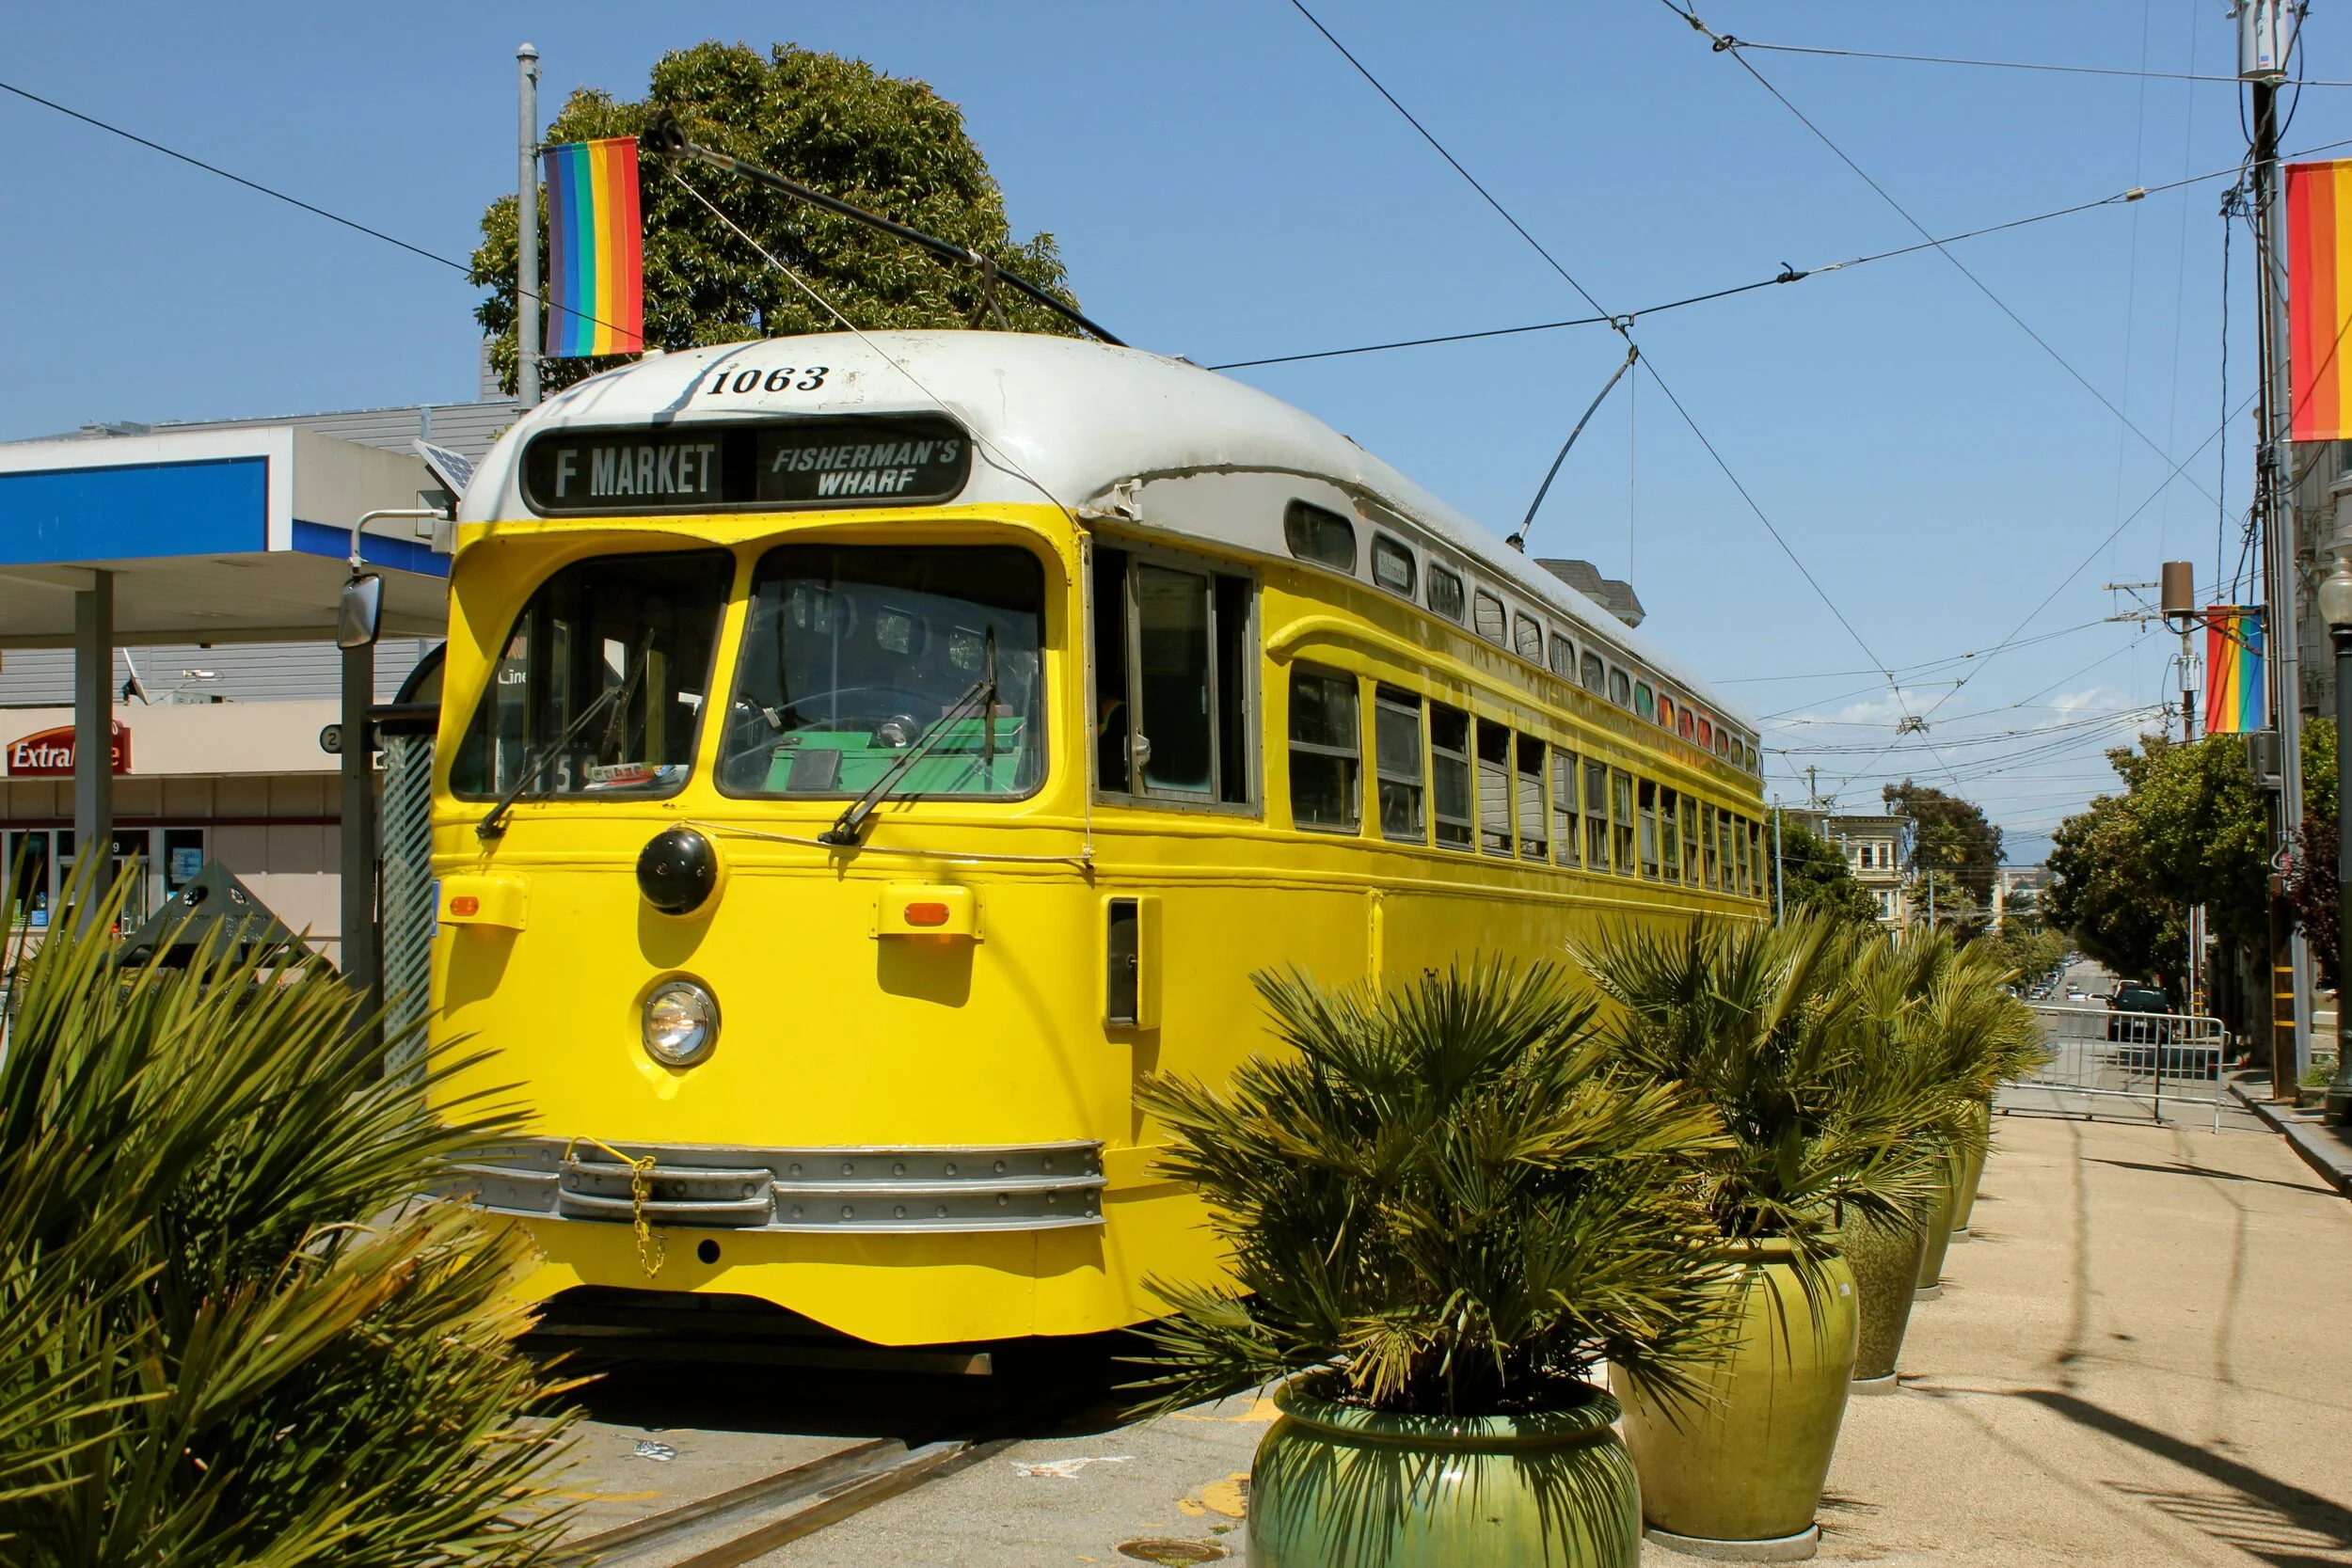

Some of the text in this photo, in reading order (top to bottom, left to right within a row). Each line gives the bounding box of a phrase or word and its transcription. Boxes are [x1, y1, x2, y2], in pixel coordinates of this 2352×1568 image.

[707, 366, 830, 395] 1063
[555, 443, 715, 498] F MARKET
[771, 439, 961, 473] FISHERMAN'S
[818, 467, 916, 497] WHARF
[1379, 553, 1407, 583] Baltimore
[327, 732, 338, 746] 2
[12, 741, 121, 768] Extrae
